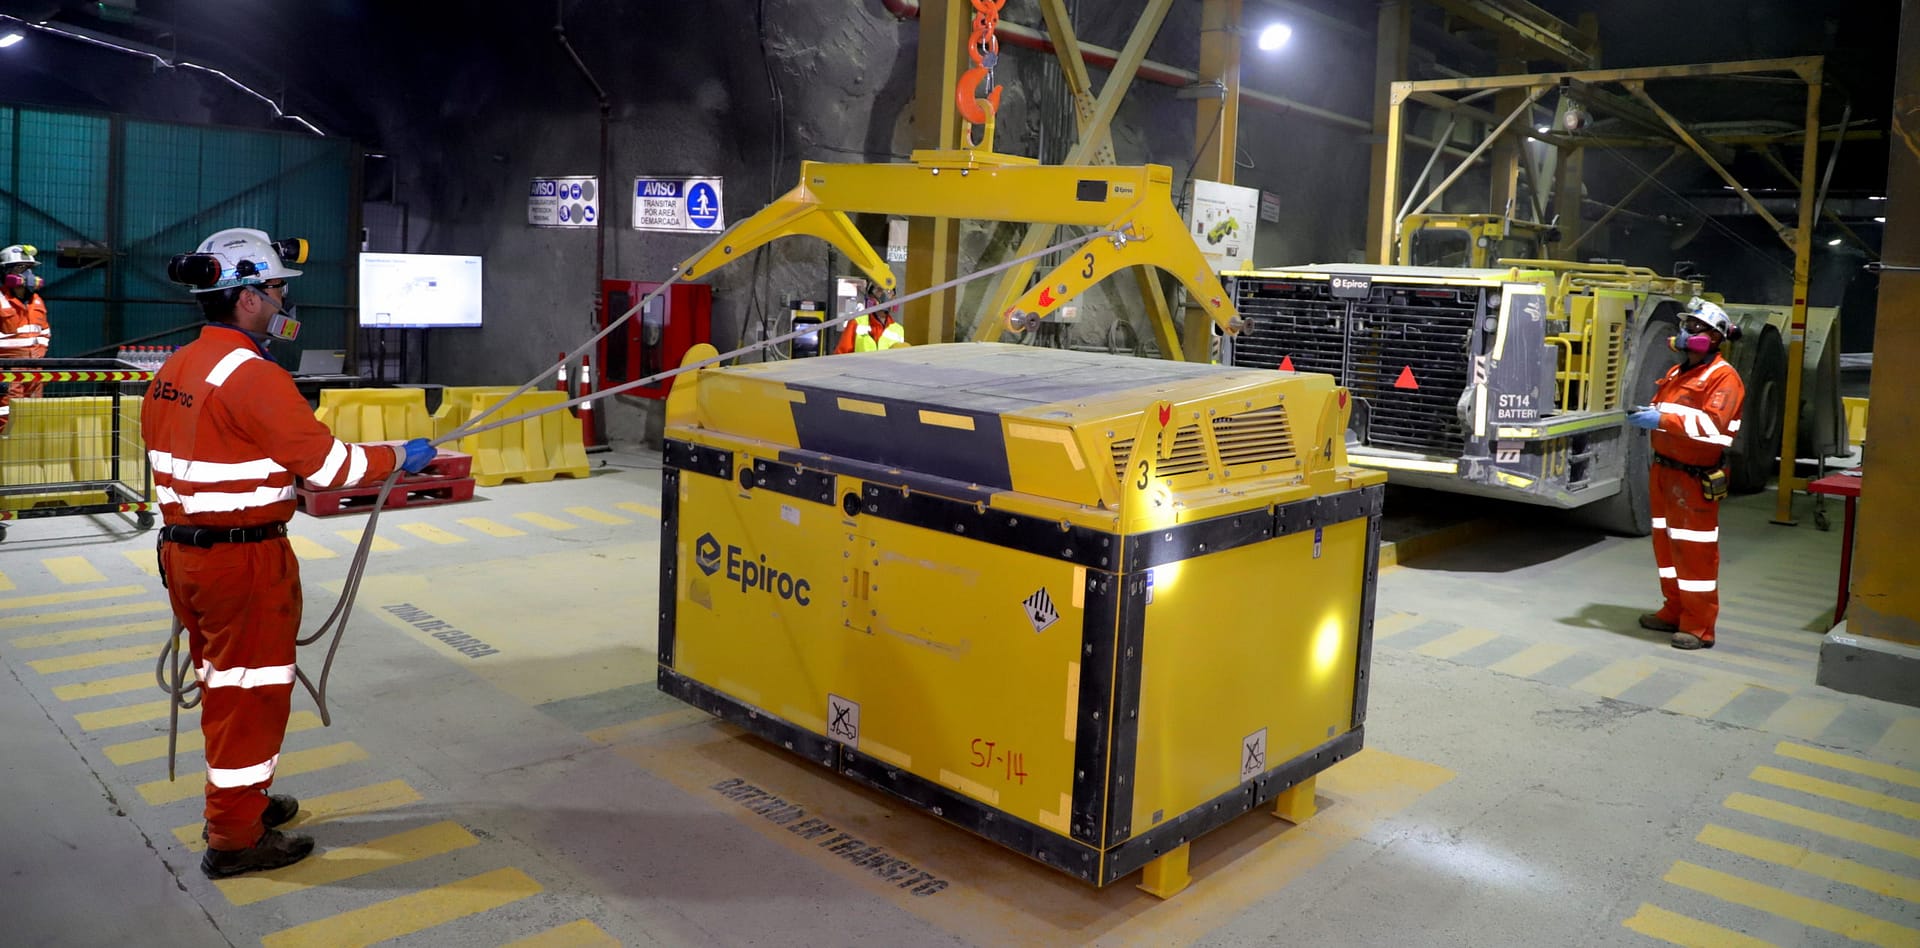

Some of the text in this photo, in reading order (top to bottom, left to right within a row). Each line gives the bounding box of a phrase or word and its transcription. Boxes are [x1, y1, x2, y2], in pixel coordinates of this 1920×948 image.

[531, 182, 554, 196] AVISO
[643, 182, 676, 196] AVISO
[644, 199, 677, 208] TRANSITAR
[645, 208, 676, 217] POR AREA
[641, 217, 680, 226] DEMARCADA
[1082, 252, 1095, 279] 3
[1342, 279, 1369, 290] Epiroc
[161, 382, 193, 408] Eproc
[1499, 394, 1530, 407] ST14
[1498, 408, 1538, 418] BATTERY
[1323, 437, 1332, 461] 4
[1137, 459, 1149, 490] 3
[726, 544, 811, 607] Epiroc
[381, 602, 501, 659] ZONA DE CARGA
[970, 738, 1028, 785] ST-14
